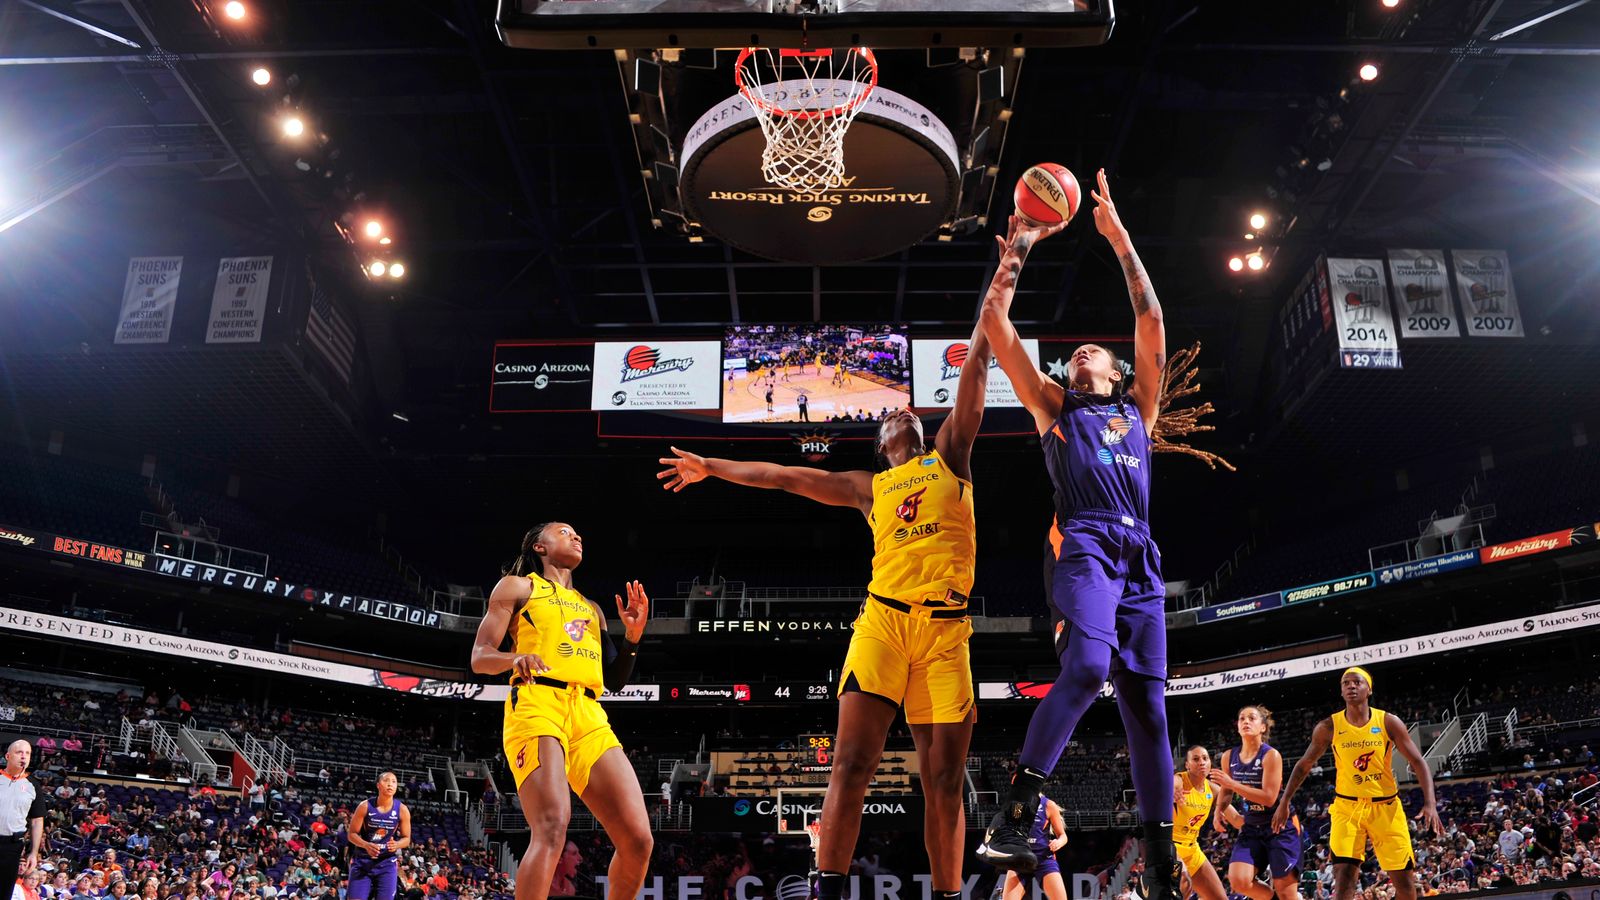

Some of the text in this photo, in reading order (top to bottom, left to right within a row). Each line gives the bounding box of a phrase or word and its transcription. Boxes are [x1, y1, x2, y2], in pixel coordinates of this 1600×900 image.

[709, 191, 784, 205] RESORT
[849, 193, 931, 204] TALKING
[131, 261, 179, 272] PHOENIX
[221, 260, 269, 272] PHOENIX
[138, 274, 167, 285] SUNS
[228, 273, 257, 284] SUNS
[129, 310, 163, 318] WESTERN
[220, 310, 254, 318] WESTERN
[122, 320, 166, 329] CONFERENCE
[213, 320, 257, 328] CONFERENCE
[1407, 317, 1450, 331] 2009
[1473, 317, 1514, 331] 2007
[122, 330, 163, 339] CHAMPIONS
[213, 329, 255, 338] CHAMPIONS
[1347, 328, 1387, 342] 2014
[1353, 354, 1370, 366] 29
[623, 356, 694, 381] Mercury
[801, 443, 830, 453] PHX
[1115, 453, 1140, 469] AT&T
[882, 472, 939, 496] salesforce
[910, 523, 940, 537] AT&T
[54, 537, 123, 564] BEST FANS
[1490, 539, 1560, 559] Mercury
[134, 552, 146, 562] THE
[1438, 552, 1474, 567] BlueShield
[124, 558, 143, 568] WNBA
[159, 560, 295, 597] MERCURY
[1354, 577, 1368, 587] FM
[1216, 601, 1256, 617] Southwest
[698, 621, 770, 632] EFFEN
[777, 621, 833, 630] VODKA
[123, 632, 144, 645] BY
[576, 648, 600, 662] AT&T
[1164, 677, 1214, 692] hoenix
[1220, 665, 1288, 685] Mercury
[1312, 643, 1409, 670] PRESENTED
[1417, 638, 1437, 651] BY
[1581, 610, 1600, 621] STIC
[601, 686, 655, 700] ercury
[671, 688, 679, 698] 6
[688, 687, 732, 697] Mercury
[774, 686, 790, 697] 44
[808, 686, 828, 694] 9:26
[809, 737, 830, 747] 9:26
[1341, 740, 1383, 749] salesforce
[817, 747, 829, 764] 6
[1364, 772, 1383, 783] AT&T
